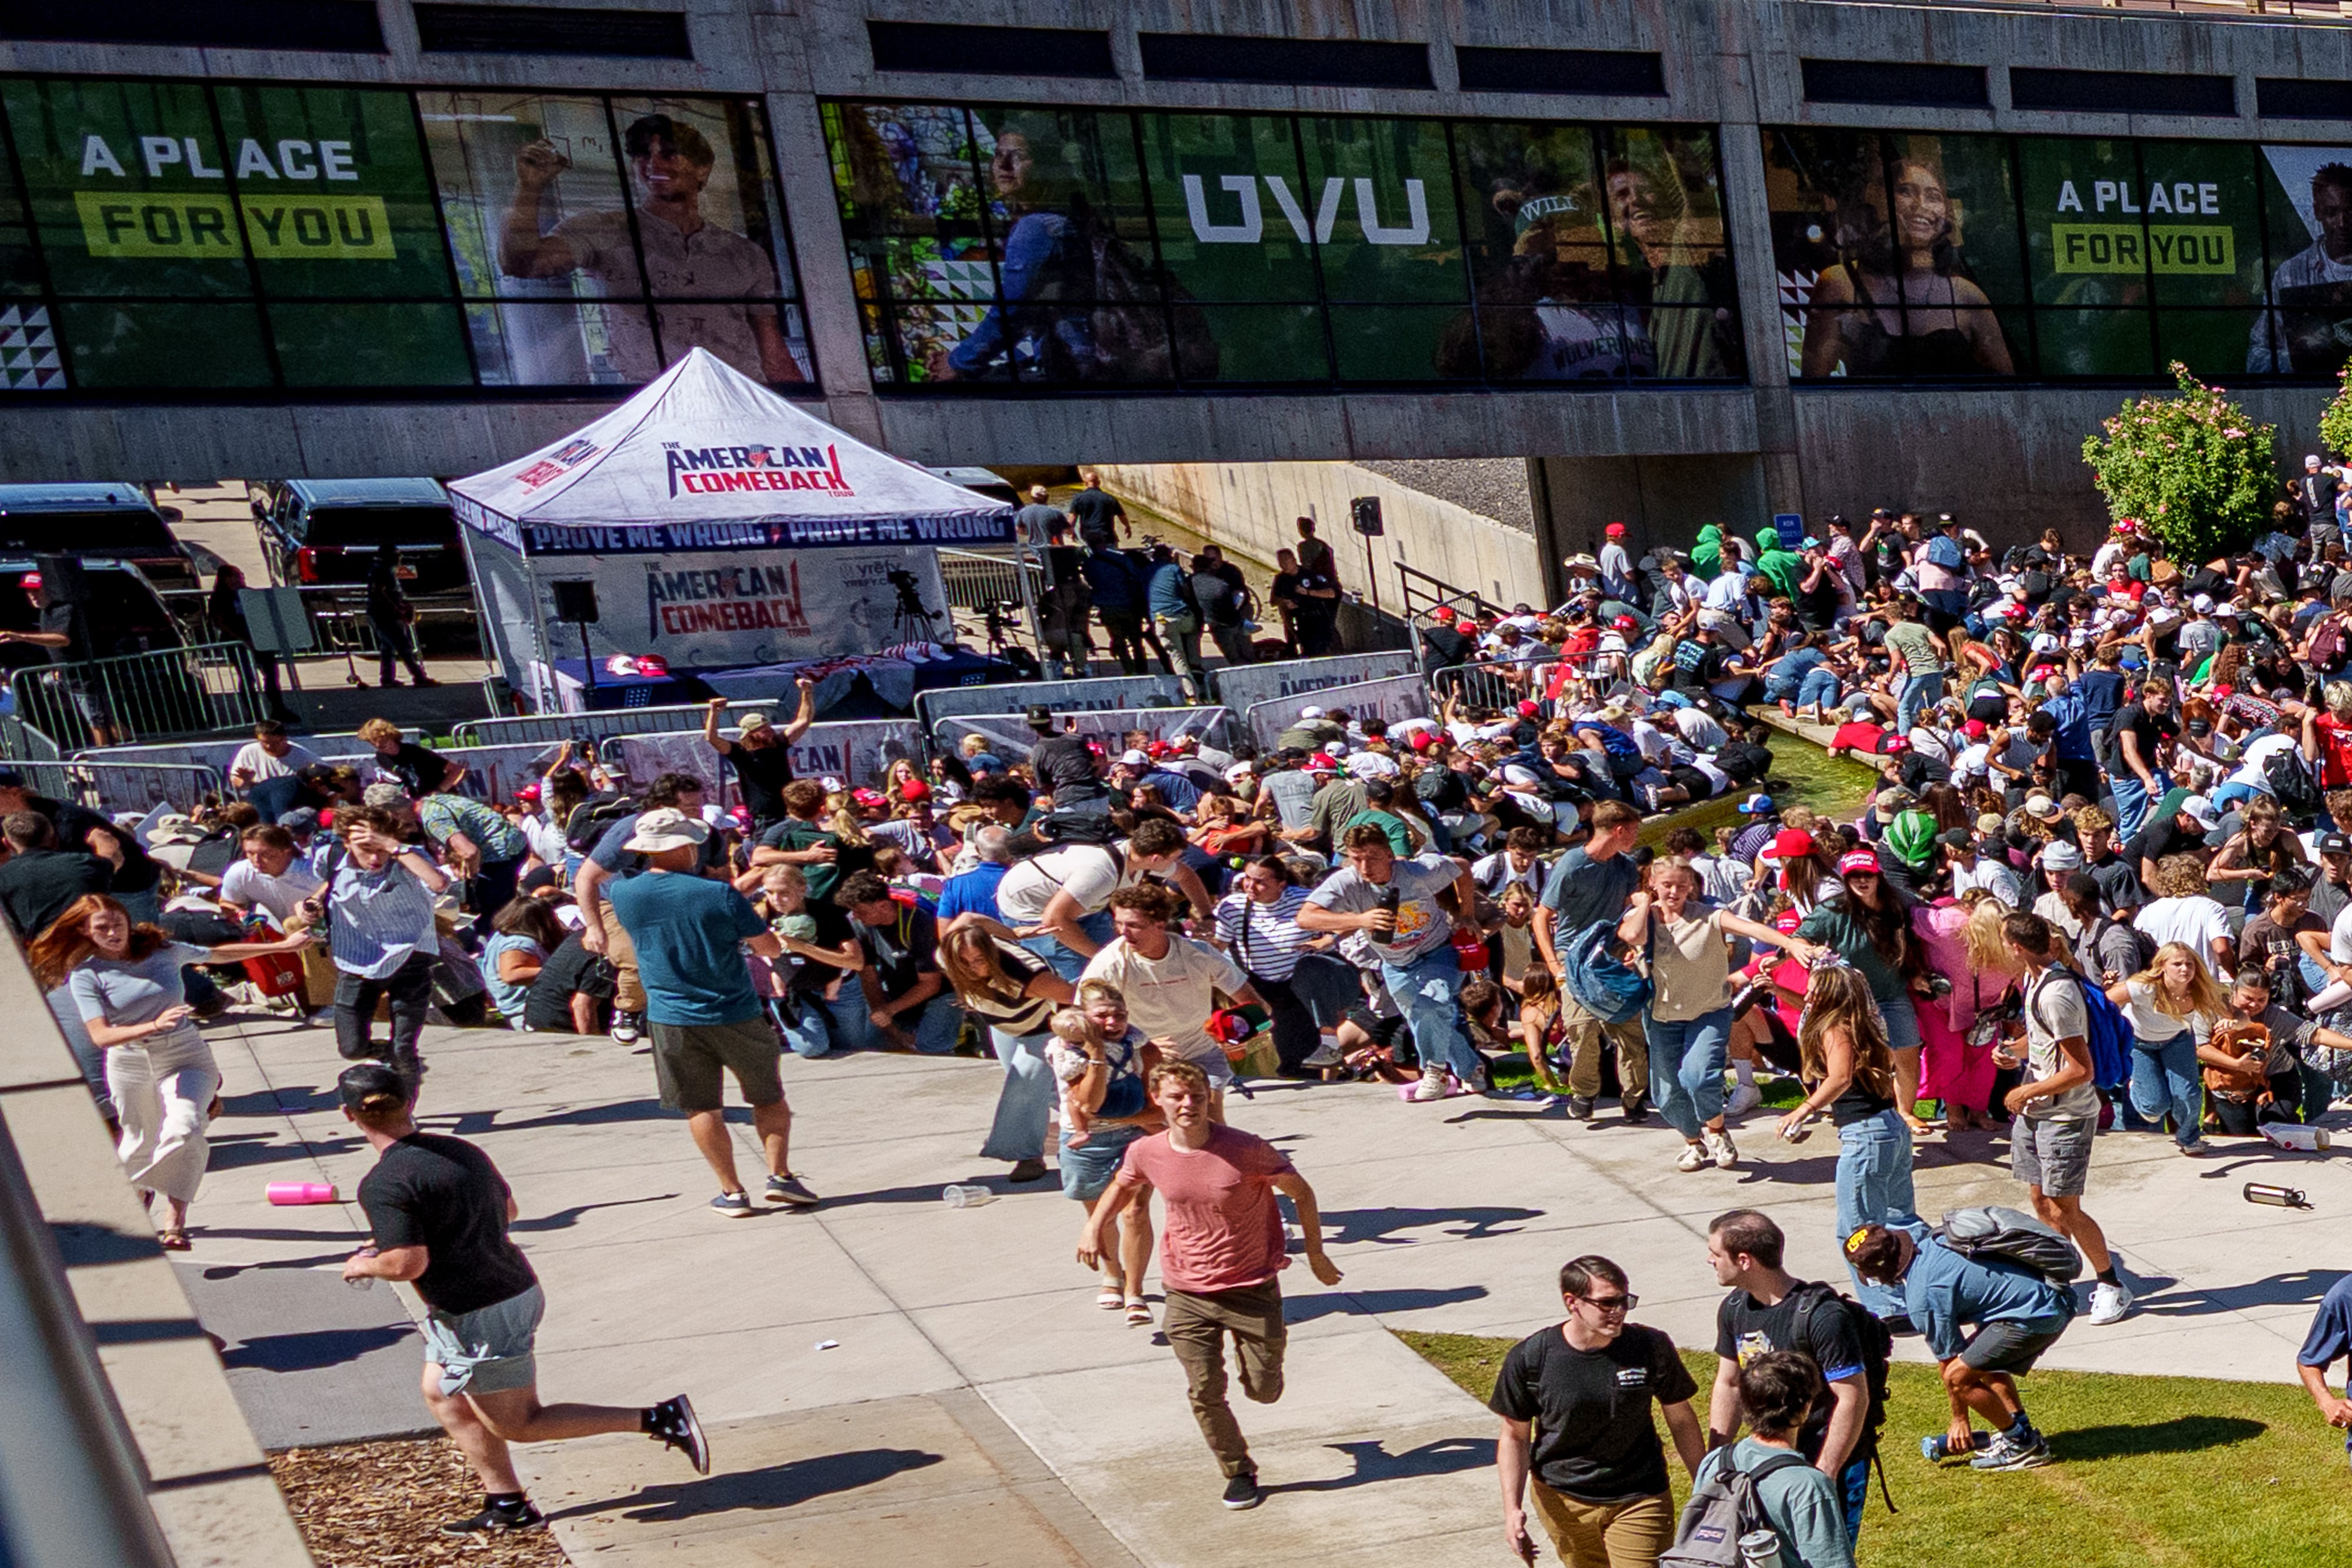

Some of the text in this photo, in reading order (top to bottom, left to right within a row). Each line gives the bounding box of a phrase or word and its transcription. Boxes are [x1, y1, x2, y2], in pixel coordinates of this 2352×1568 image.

[81, 135, 359, 180] A PLACE
[1182, 174, 1431, 245] UVU
[2057, 180, 2220, 215] A PLACE
[99, 205, 376, 247] FOR YOU
[2065, 233, 2225, 266] FOR YOU
[666, 444, 827, 499] AMERICAN
[681, 443, 850, 493] COMEBACK
[532, 516, 1006, 550] PROVE ME WRONG PROVE ME WRONG
[647, 565, 789, 644] AMERICAN
[660, 559, 810, 636] COMEBACK
